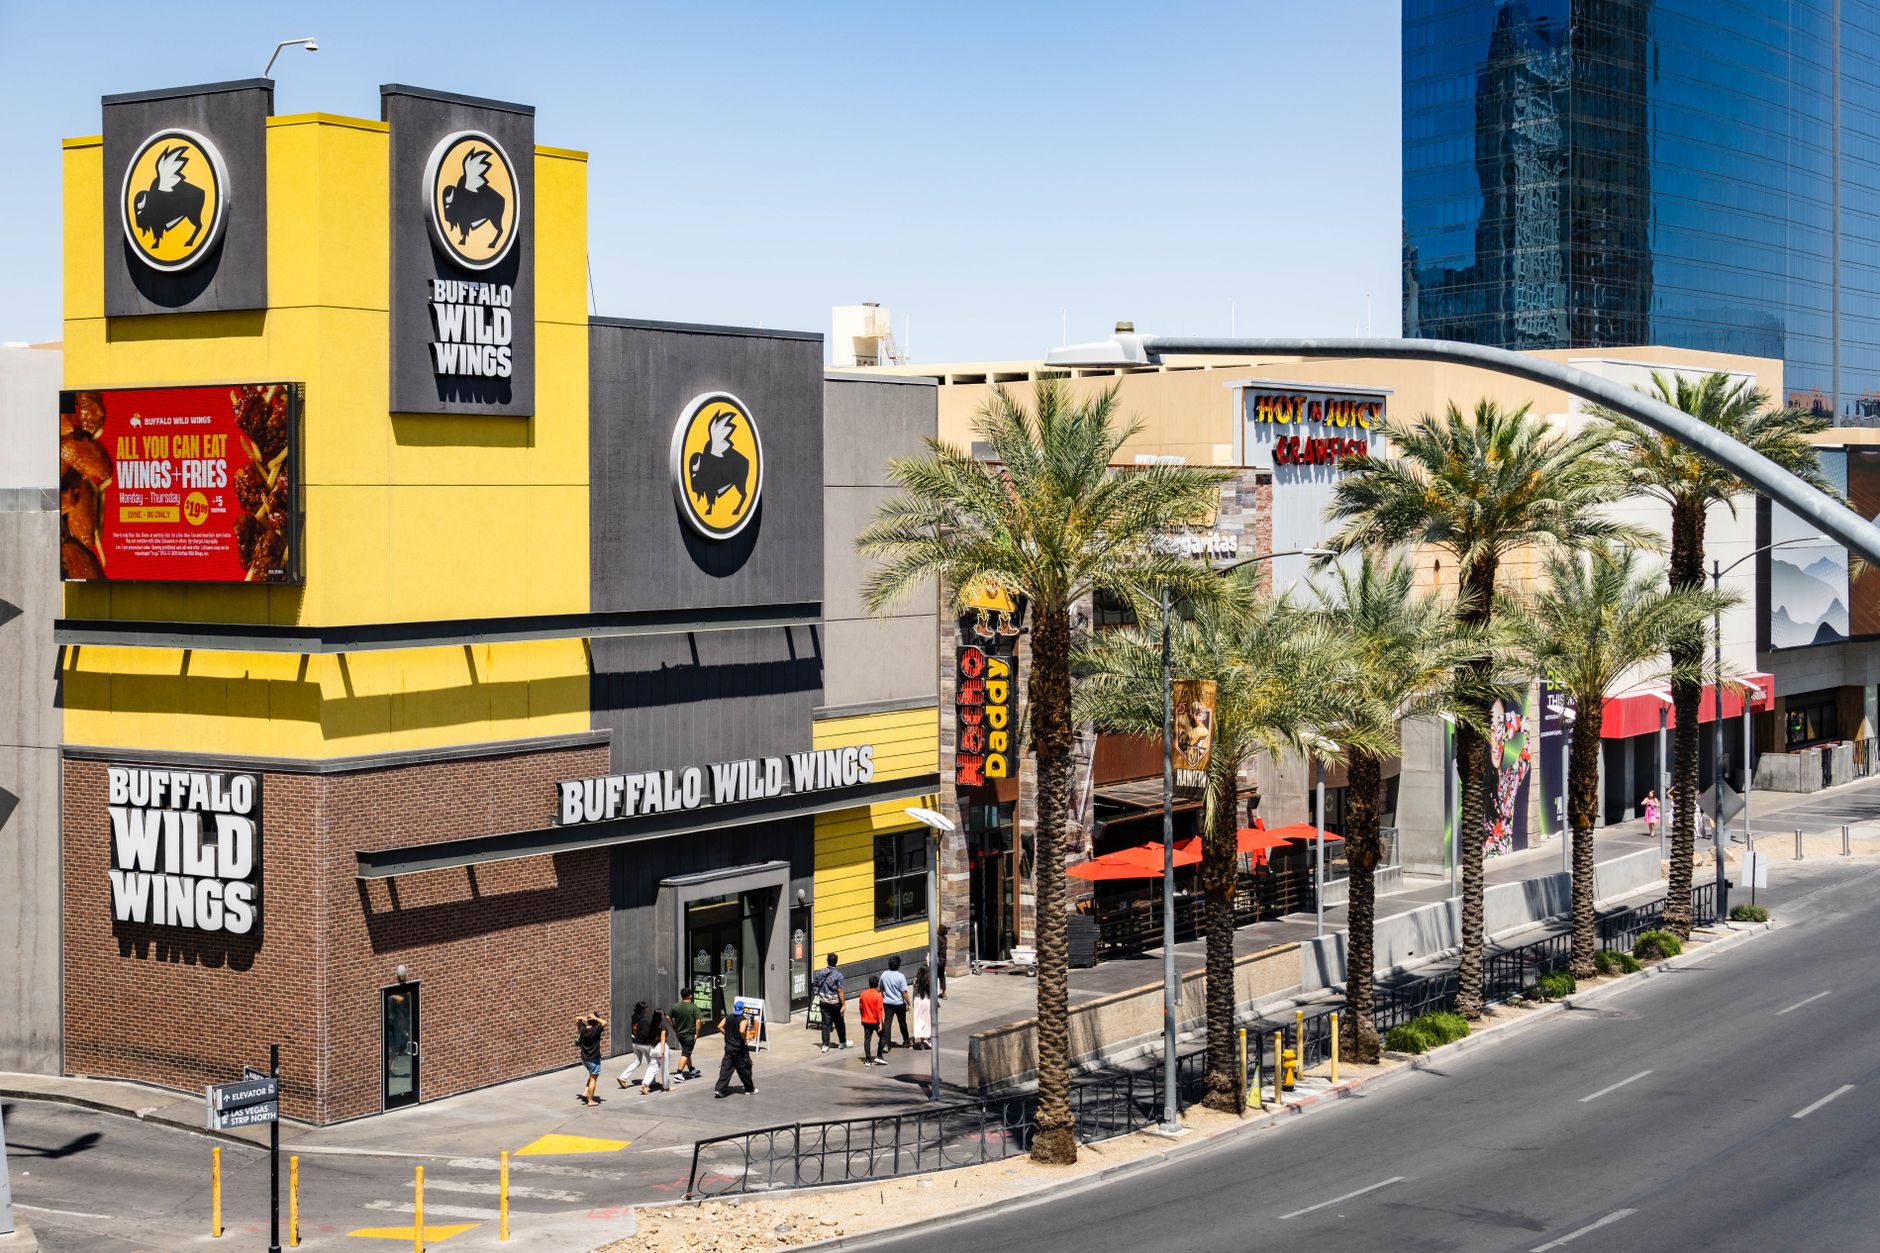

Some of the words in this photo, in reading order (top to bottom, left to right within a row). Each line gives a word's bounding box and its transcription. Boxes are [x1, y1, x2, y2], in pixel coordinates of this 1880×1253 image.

[433, 279, 512, 308] BUFFALO
[432, 303, 512, 346] WILD
[433, 342, 512, 378] WINGS
[144, 417, 172, 426] BUFFALO
[173, 416, 190, 425] WILD
[190, 416, 212, 425] WINGS
[1257, 395, 1307, 425] HOT
[1309, 400, 1322, 422] N
[1325, 398, 1383, 430] JUICY
[116, 436, 140, 460] ALL
[142, 435, 169, 460] YOU
[172, 434, 200, 459] CAN
[203, 434, 228, 459] EAT
[1274, 435, 1368, 466] CRAWFISH
[119, 492, 144, 506] Monday
[150, 491, 181, 506] Thursday
[128, 510, 143, 519] DINE
[154, 510, 171, 519] ONLY
[985, 657, 1009, 778] Daddy
[107, 767, 254, 814] BUFFALO
[560, 766, 702, 825] BUFFALO
[709, 757, 783, 804] WILD
[788, 744, 874, 793] WINGS
[107, 807, 254, 879] WILD
[107, 870, 255, 935] WINGS
[793, 973, 806, 984] TAKE
[794, 983, 806, 994] OUT
[231, 1087, 267, 1101] ELEVATOR
[230, 1109, 244, 1118] LAS
[244, 1105, 269, 1115] VEGAS
[230, 1115, 250, 1126] STRIP
[251, 1112, 277, 1123] NORTH
